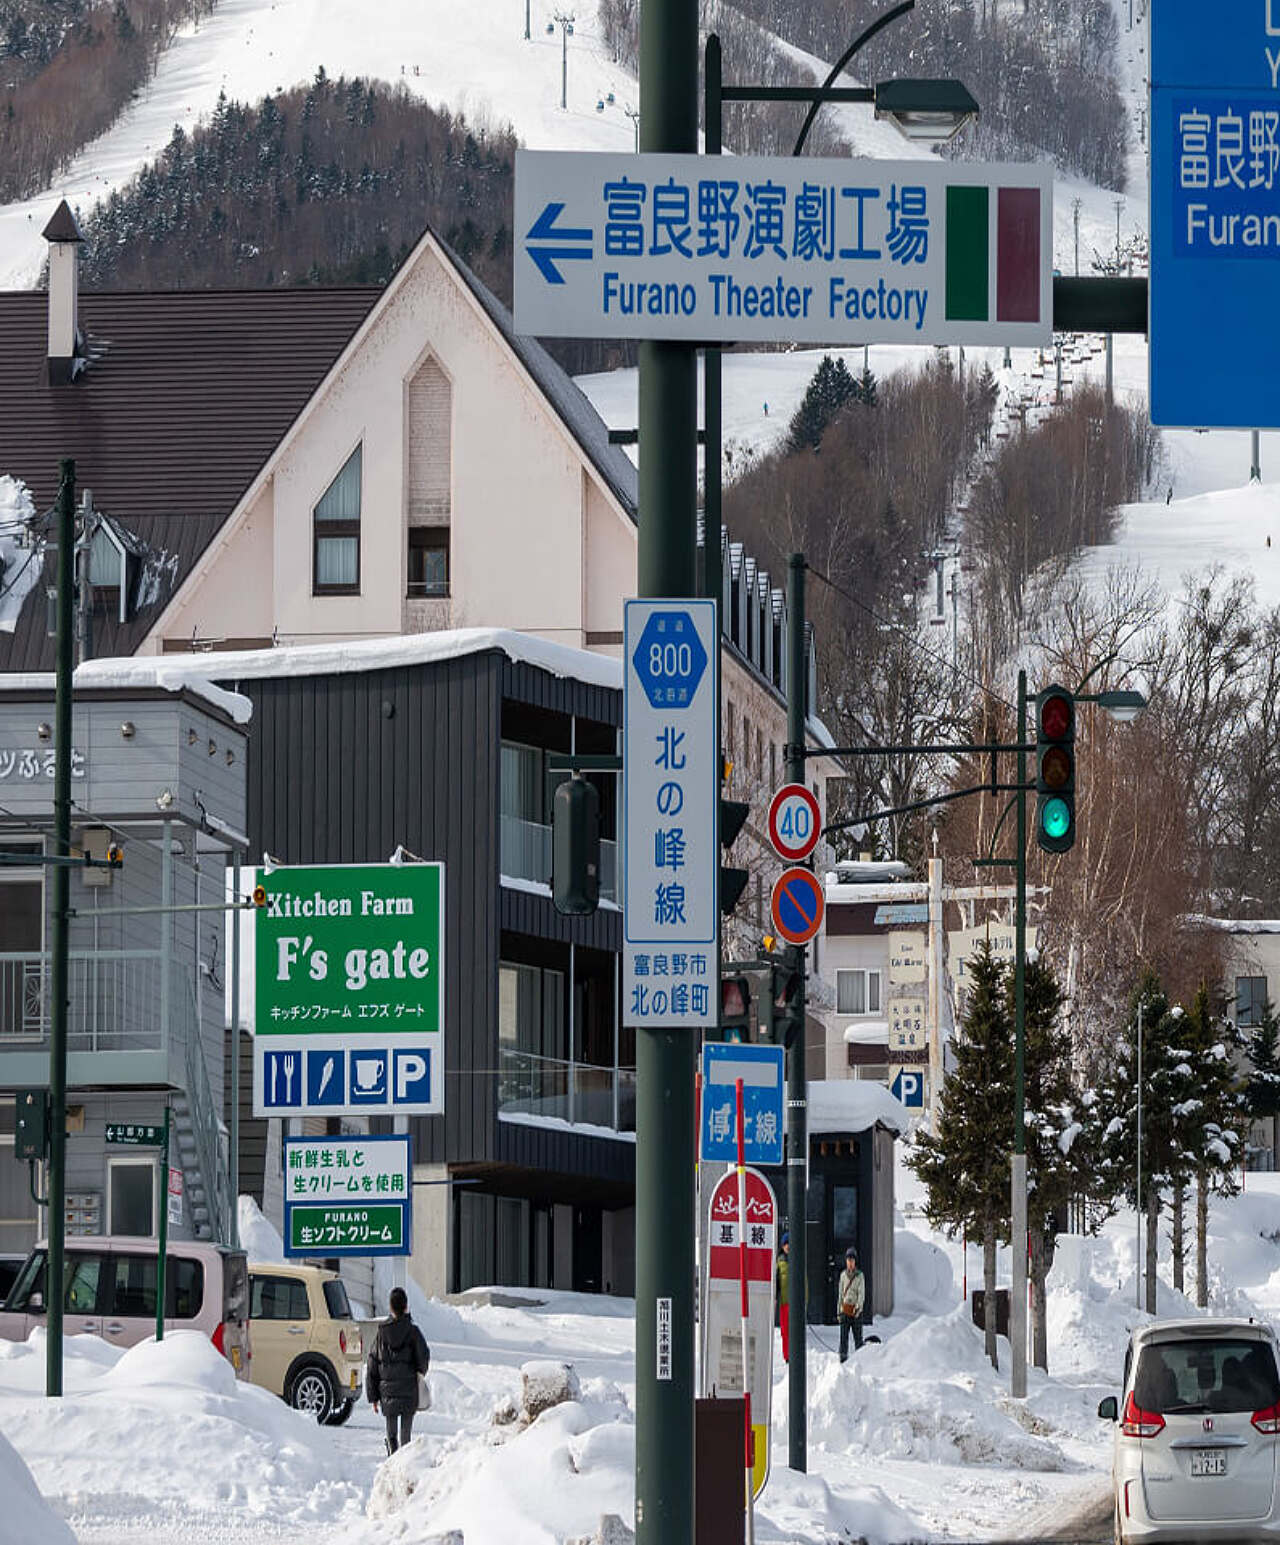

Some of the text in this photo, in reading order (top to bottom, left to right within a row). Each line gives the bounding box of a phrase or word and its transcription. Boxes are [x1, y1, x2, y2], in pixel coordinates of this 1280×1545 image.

[603, 176, 930, 265] 富良野演劇工場
[603, 273, 929, 330] Furano Theater Factory
[650, 644, 691, 676] 800
[655, 727, 686, 925] 北の峰線
[780, 806, 809, 839] 40
[267, 891, 413, 917] Kitchen Farm
[277, 936, 429, 990] F's gate
[633, 954, 706, 976] 富良野市
[271, 1005, 352, 1020] キッチンファーム
[394, 1003, 425, 1018] ゲート
[631, 984, 709, 1017] 北の峰町
[398, 1055, 426, 1098] P
[901, 1074, 917, 1105] P
[289, 1149, 365, 1169] 新鮮生乳と
[293, 1174, 404, 1194] 生クリームを使用
[324, 1211, 368, 1223] FURANO
[300, 1226, 393, 1243] 生ソフトクリーム
